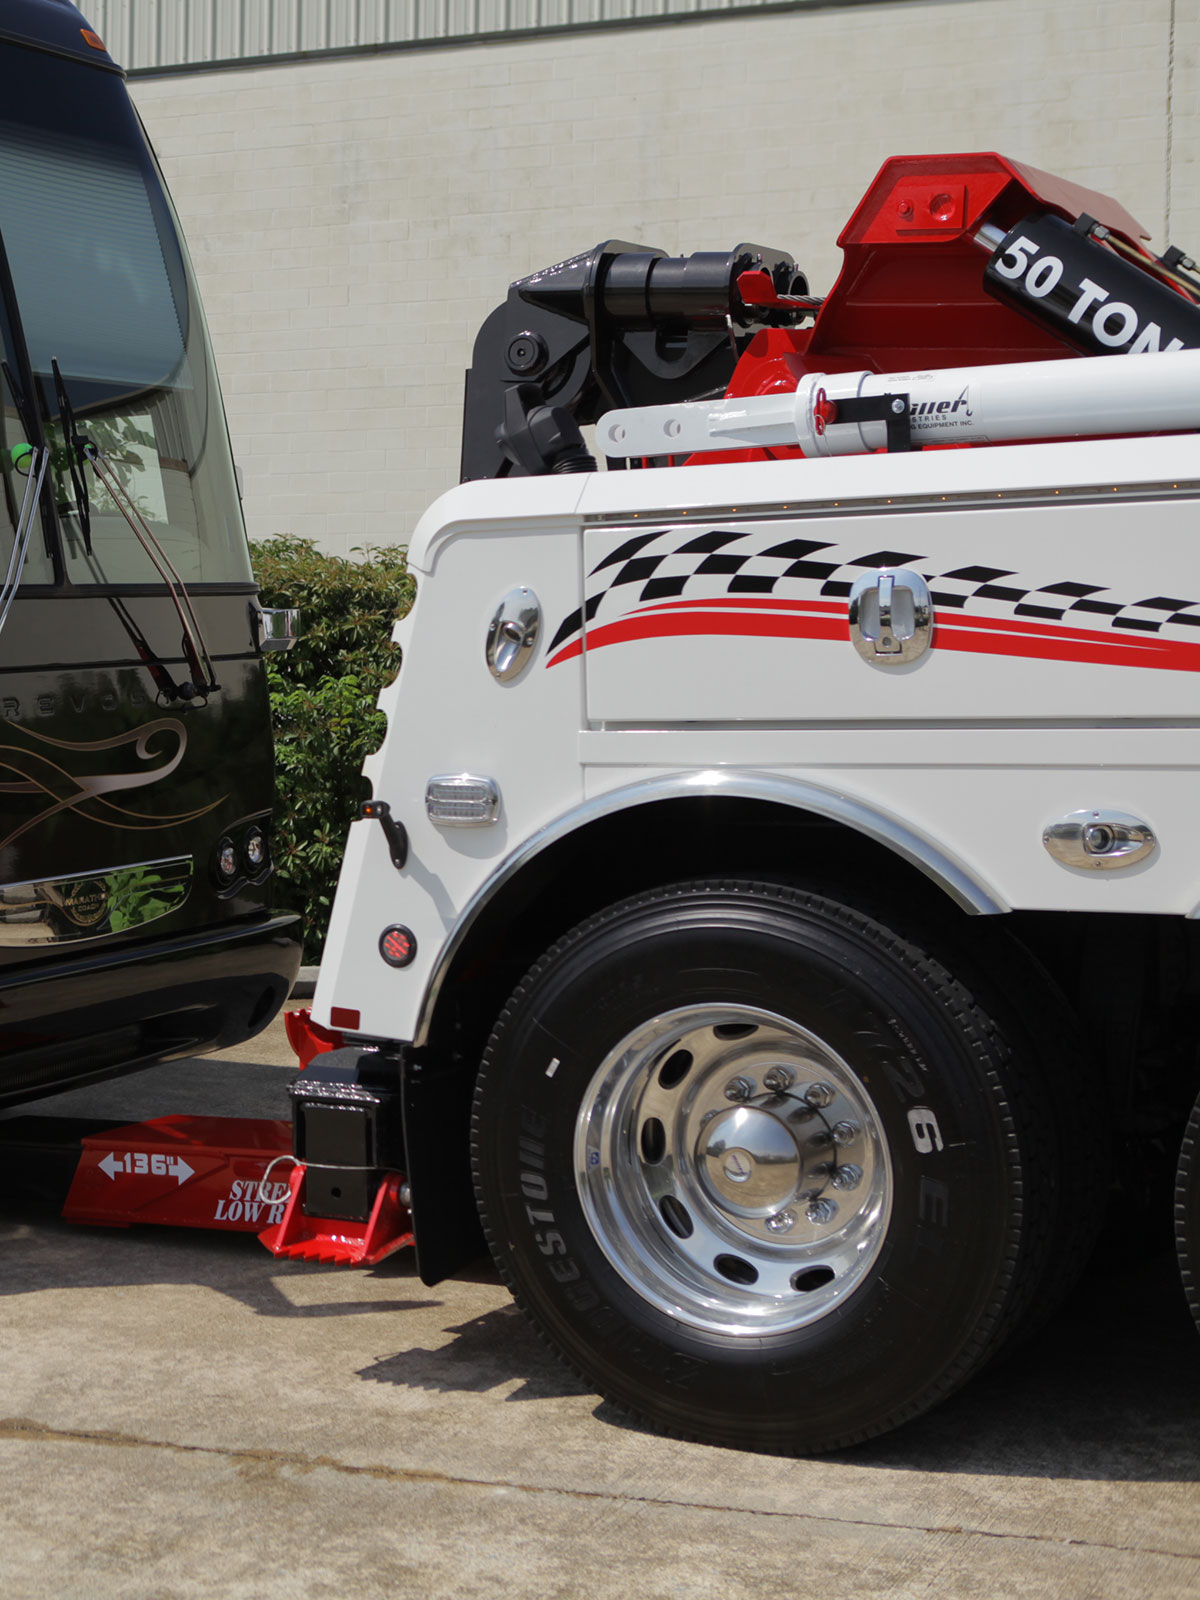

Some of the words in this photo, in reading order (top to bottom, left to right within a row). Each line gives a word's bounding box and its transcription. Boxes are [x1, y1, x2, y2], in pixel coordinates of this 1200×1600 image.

[994, 235, 1064, 298] 50
[910, 399, 968, 416] iller
[917, 421, 958, 430] EQUIPMENT
[123, 1152, 175, 1176] 136"
[214, 1199, 267, 1223] LOW
